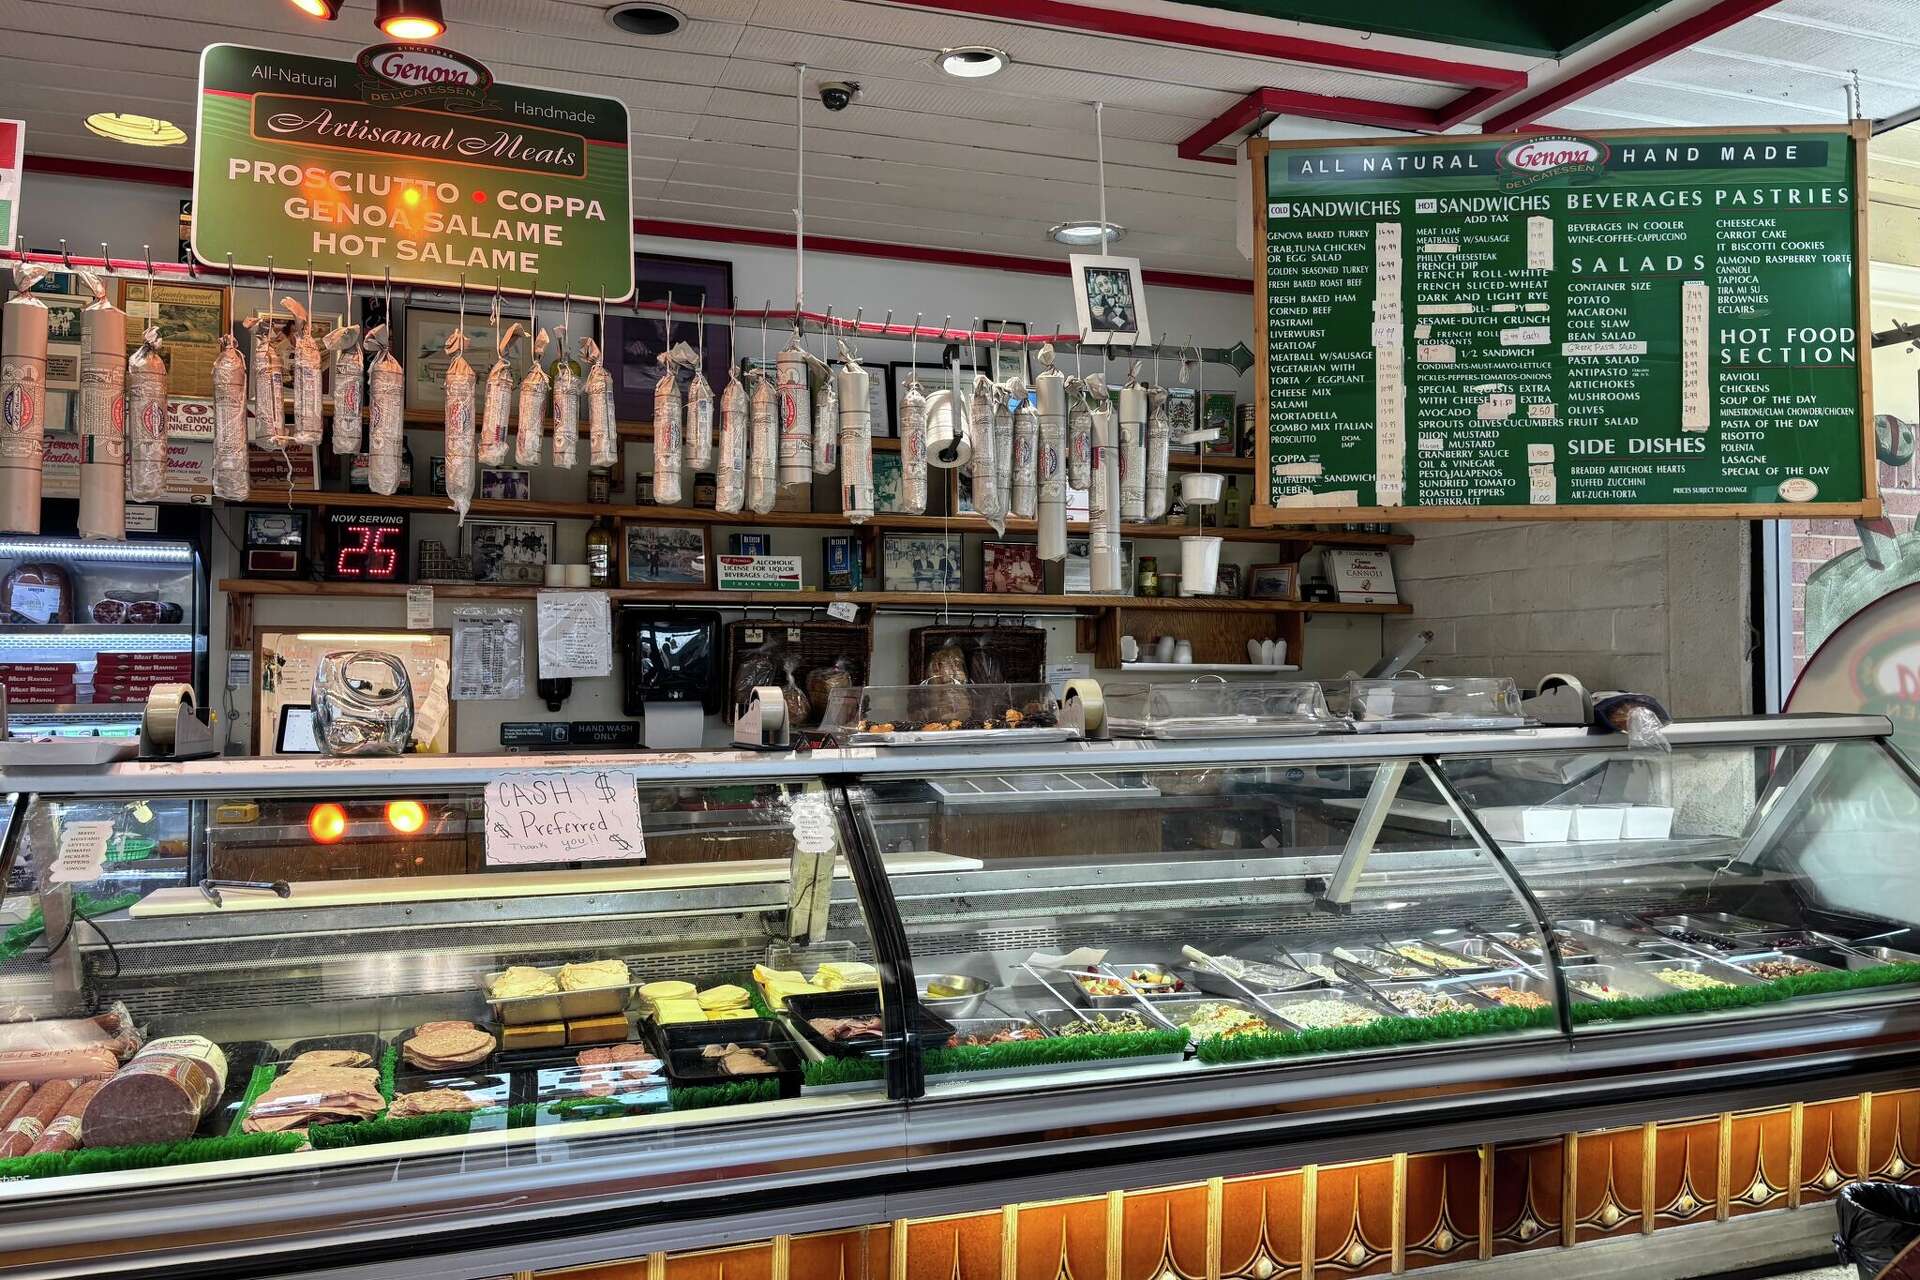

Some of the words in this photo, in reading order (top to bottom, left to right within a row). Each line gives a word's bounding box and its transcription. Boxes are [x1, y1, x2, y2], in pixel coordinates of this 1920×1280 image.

[381, 53, 469, 87] Genova
[251, 63, 338, 90] All-Natural
[371, 86, 477, 102] DELICATESSEN
[513, 101, 597, 125] Handmade
[266, 108, 455, 151] Artisanal
[456, 131, 577, 167] Meats
[1515, 145, 1589, 168] Genova
[1622, 148, 1700, 164] HAND
[1720, 146, 1798, 161] MADE
[1300, 158, 1345, 174] ALL
[1362, 153, 1480, 171] NATURAL
[1506, 164, 1595, 190] DELICATESSEN
[228, 158, 459, 205] PROSCIUTTO
[496, 190, 607, 222] COPPA
[1567, 190, 1703, 209] BEVERAGES
[1715, 187, 1850, 206] PASTRIES
[1292, 200, 1401, 218] SANDWICHES
[1440, 195, 1552, 213] SANDWICHES
[1270, 206, 1288, 214] COLD
[284, 197, 414, 231] GENOA
[422, 212, 564, 247] SALAME
[1464, 215, 1488, 224] ADD
[1491, 214, 1510, 222] TAX
[1716, 218, 1777, 228] CHEESECAKE
[1267, 232, 1303, 240] GENOVA
[1306, 231, 1334, 239] BAKED
[1338, 230, 1369, 238] TURKEY
[1716, 231, 1757, 240] CARROT
[1761, 230, 1788, 239] CAKE
[1716, 243, 1726, 252] IT
[1731, 242, 1776, 251] BISCOTTI
[1780, 241, 1825, 250] COOKIES
[312, 231, 387, 258] HOT
[396, 239, 541, 275] SALAME
[1416, 254, 1443, 262] PHILLY
[1446, 253, 1498, 261] CHEESESTEAK
[1571, 254, 1706, 274] SALADS
[1716, 255, 1761, 265] ALMOND
[1765, 254, 1817, 264] RASPBERRY
[1822, 254, 1852, 263] TORTE
[1715, 266, 1751, 275] CANNOLI
[1717, 275, 1760, 284] TAPIOCA
[1717, 286, 1734, 295] TIRA
[1737, 286, 1748, 295] MI
[1751, 285, 1761, 294] SU
[1418, 294, 1449, 302] DARK
[1454, 293, 1481, 301] AND
[1487, 292, 1521, 301] LIGHT
[1528, 292, 1549, 300] RYE
[1567, 295, 1610, 304] POTATO
[1717, 294, 1769, 304] BROWNIES
[1269, 307, 1308, 315] CORNED
[1313, 306, 1333, 314] BEEF
[1567, 307, 1628, 316] MACARONI
[1717, 305, 1756, 314] ECLAIRS
[1270, 318, 1313, 327] PASTRAMI
[1417, 316, 1498, 325] SESAME-DUTCH
[1503, 315, 1551, 324] CRUNCH
[1567, 319, 1596, 329] COLE
[1601, 319, 1631, 328] SLAW
[1270, 330, 1326, 338] LIVERWURST
[1719, 328, 1772, 345] HOT
[1786, 327, 1856, 344] FOOD
[1270, 341, 1318, 350] MEATLOAF
[1720, 347, 1856, 364] SECTION
[1270, 364, 1326, 373] VEGETARIAN
[1568, 368, 1629, 377] ANTIPASTO
[1719, 373, 1761, 382] RAVIOLI
[1568, 379, 1636, 389] ARTICHOKES
[1271, 388, 1308, 397] CHEESE
[1312, 388, 1333, 396] MIX
[1719, 385, 1770, 394] CHICKENS
[1568, 392, 1641, 401] MUSHROOMS
[1271, 400, 1309, 409] SALAMI
[1568, 405, 1605, 414] OLIVES
[1270, 412, 1338, 421] MORTADELLA
[1418, 408, 1472, 417] AVOCADO
[1719, 407, 1785, 417] MINESTRONE/CLAM
[1787, 406, 1855, 416] CHOWDER/CHICKEN
[1418, 420, 1464, 429] SPROUTS
[1468, 419, 1502, 428] OLIVES
[1503, 418, 1565, 428] CUCUMBERS
[1568, 417, 1599, 426] FRUIT
[1604, 416, 1640, 426] SALAD
[1270, 423, 1308, 432] COMBO
[1311, 423, 1331, 431] MIX
[1334, 422, 1374, 431] ITALIAN
[1271, 435, 1317, 444] PROSCIUTTO
[1721, 431, 1766, 441] RISOTTO
[1568, 439, 1617, 455] SIDE
[1629, 437, 1707, 455] DISHES
[1720, 443, 1756, 453] POLENTA
[1271, 455, 1307, 463] COPPA
[1418, 451, 1474, 460] CRANBERRY
[1478, 450, 1511, 459] SAUCE
[1721, 455, 1768, 464] LASAGNE
[1418, 461, 1436, 470] OIL
[1440, 461, 1449, 469] &
[1452, 460, 1496, 469] VINEGAR
[1571, 466, 1606, 475] BREADED
[1609, 465, 1653, 474] ARTICHOKE
[1657, 464, 1687, 473] HEARTS
[1418, 479, 1469, 488] SUNDRIED
[1474, 478, 1517, 487] TOMATO
[1571, 478, 1604, 487] STUFFED
[1608, 477, 1647, 486] ZUCCHINI
[1418, 489, 1463, 498] ROASTED
[1467, 487, 1506, 497] PEPPERS
[1571, 489, 1638, 499] ART-ZUCH-TORTA
[1673, 486, 1691, 494] PRICES
[1715, 486, 1724, 494] TO
[1724, 485, 1747, 493] CHANGE
[1418, 498, 1482, 506] SAUERKRAUT
[331, 514, 357, 523] NOW
[358, 515, 404, 524] SERVING
[337, 526, 399, 573] 25
[724, 571, 761, 579] BEVERAGES
[1346, 569, 1383, 578] CANNOLI
[578, 725, 605, 733] HAND
[607, 725, 632, 733] WASH
[499, 778, 573, 808] CASH
[595, 772, 616, 804] $
[519, 810, 608, 839] Preferred
[504, 842, 549, 851] Thank
